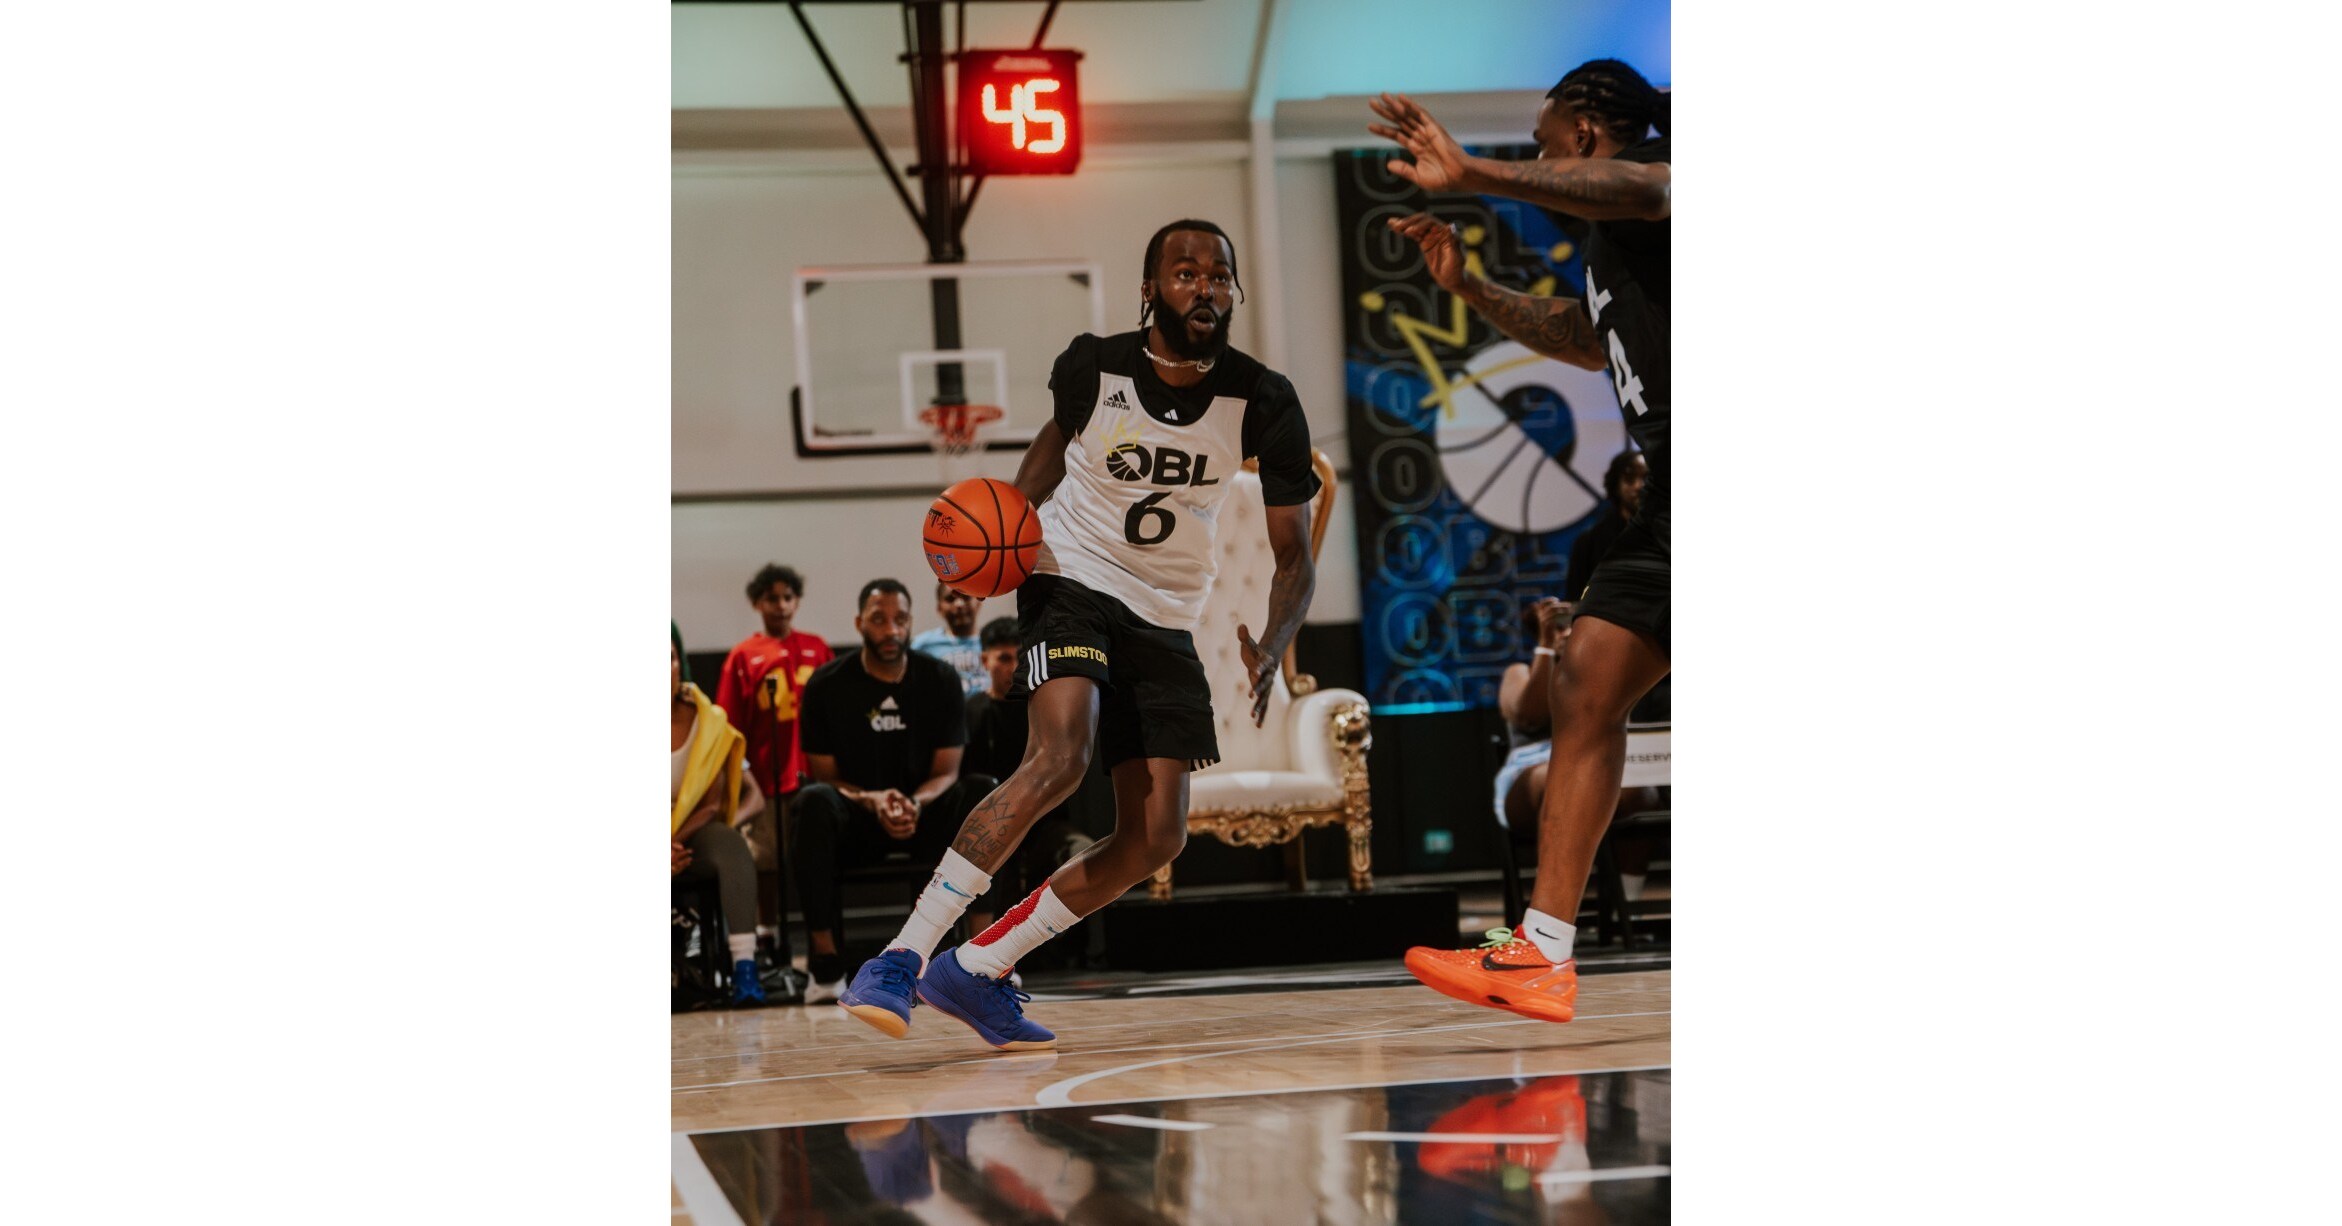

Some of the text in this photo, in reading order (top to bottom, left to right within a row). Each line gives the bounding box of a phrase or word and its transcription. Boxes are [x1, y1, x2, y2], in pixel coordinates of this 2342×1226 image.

[981, 79, 1066, 154] 45
[1103, 400, 1131, 411] adidas
[1106, 443, 1220, 488] OBL
[1124, 491, 1177, 545] 6
[870, 714, 907, 732] OBL
